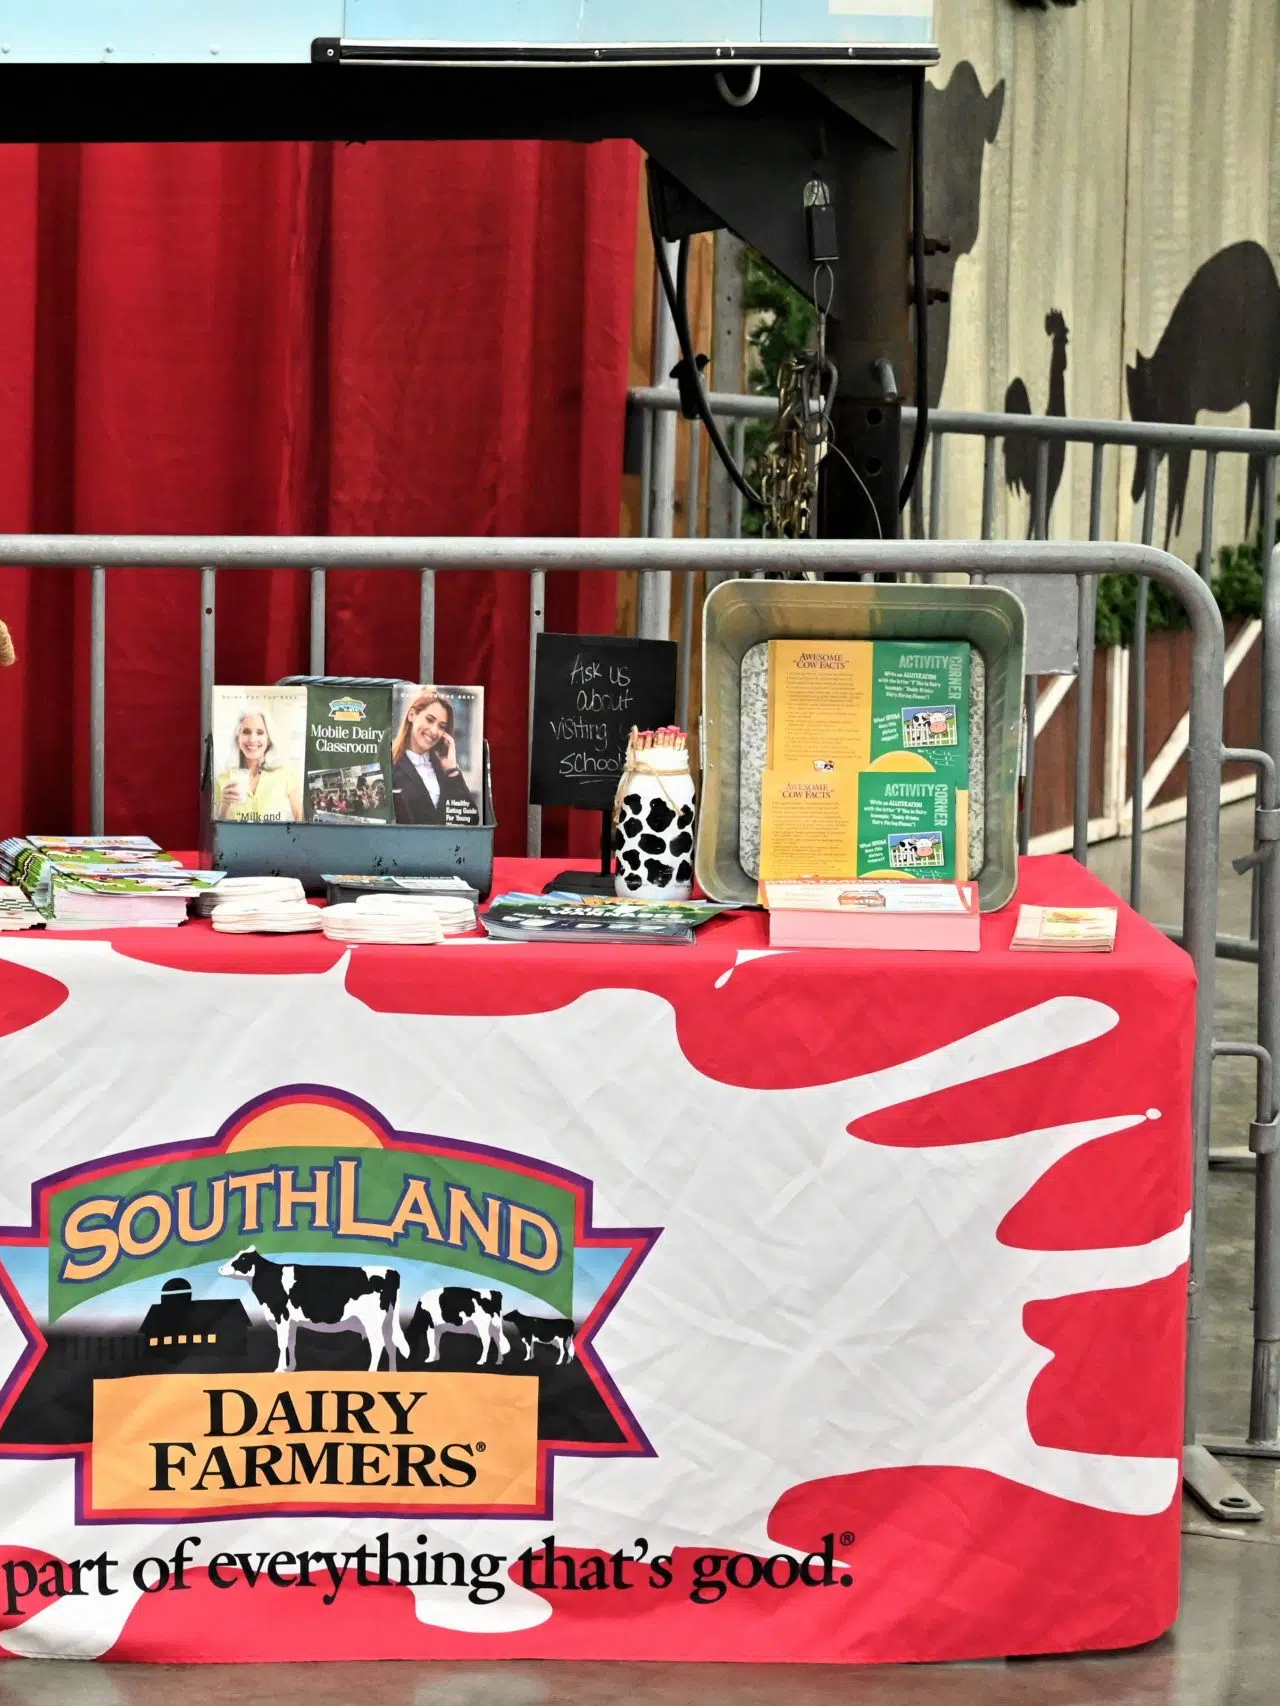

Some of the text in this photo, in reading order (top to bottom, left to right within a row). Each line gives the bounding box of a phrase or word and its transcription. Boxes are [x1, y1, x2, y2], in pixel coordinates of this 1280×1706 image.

[571, 653, 602, 685] Ask
[799, 652, 843, 661] AWESOME
[899, 655, 949, 669] ACTIVITY
[948, 656, 962, 699] CORNER
[576, 688, 633, 712] about
[310, 725, 386, 742] Mobile Dairy
[316, 739, 378, 754] Classroom
[550, 716, 608, 751] visiting
[884, 784, 934, 797] ACTIVITY
[934, 784, 948, 826] CORNER
[58, 1157, 560, 1285] SOUTHLAND
[203, 1389, 427, 1437] DAIRY
[1, 1545, 118, 1616] part
[133, 1536, 201, 1594] of
[208, 1534, 507, 1606] everything
[521, 1535, 673, 1592] that's
